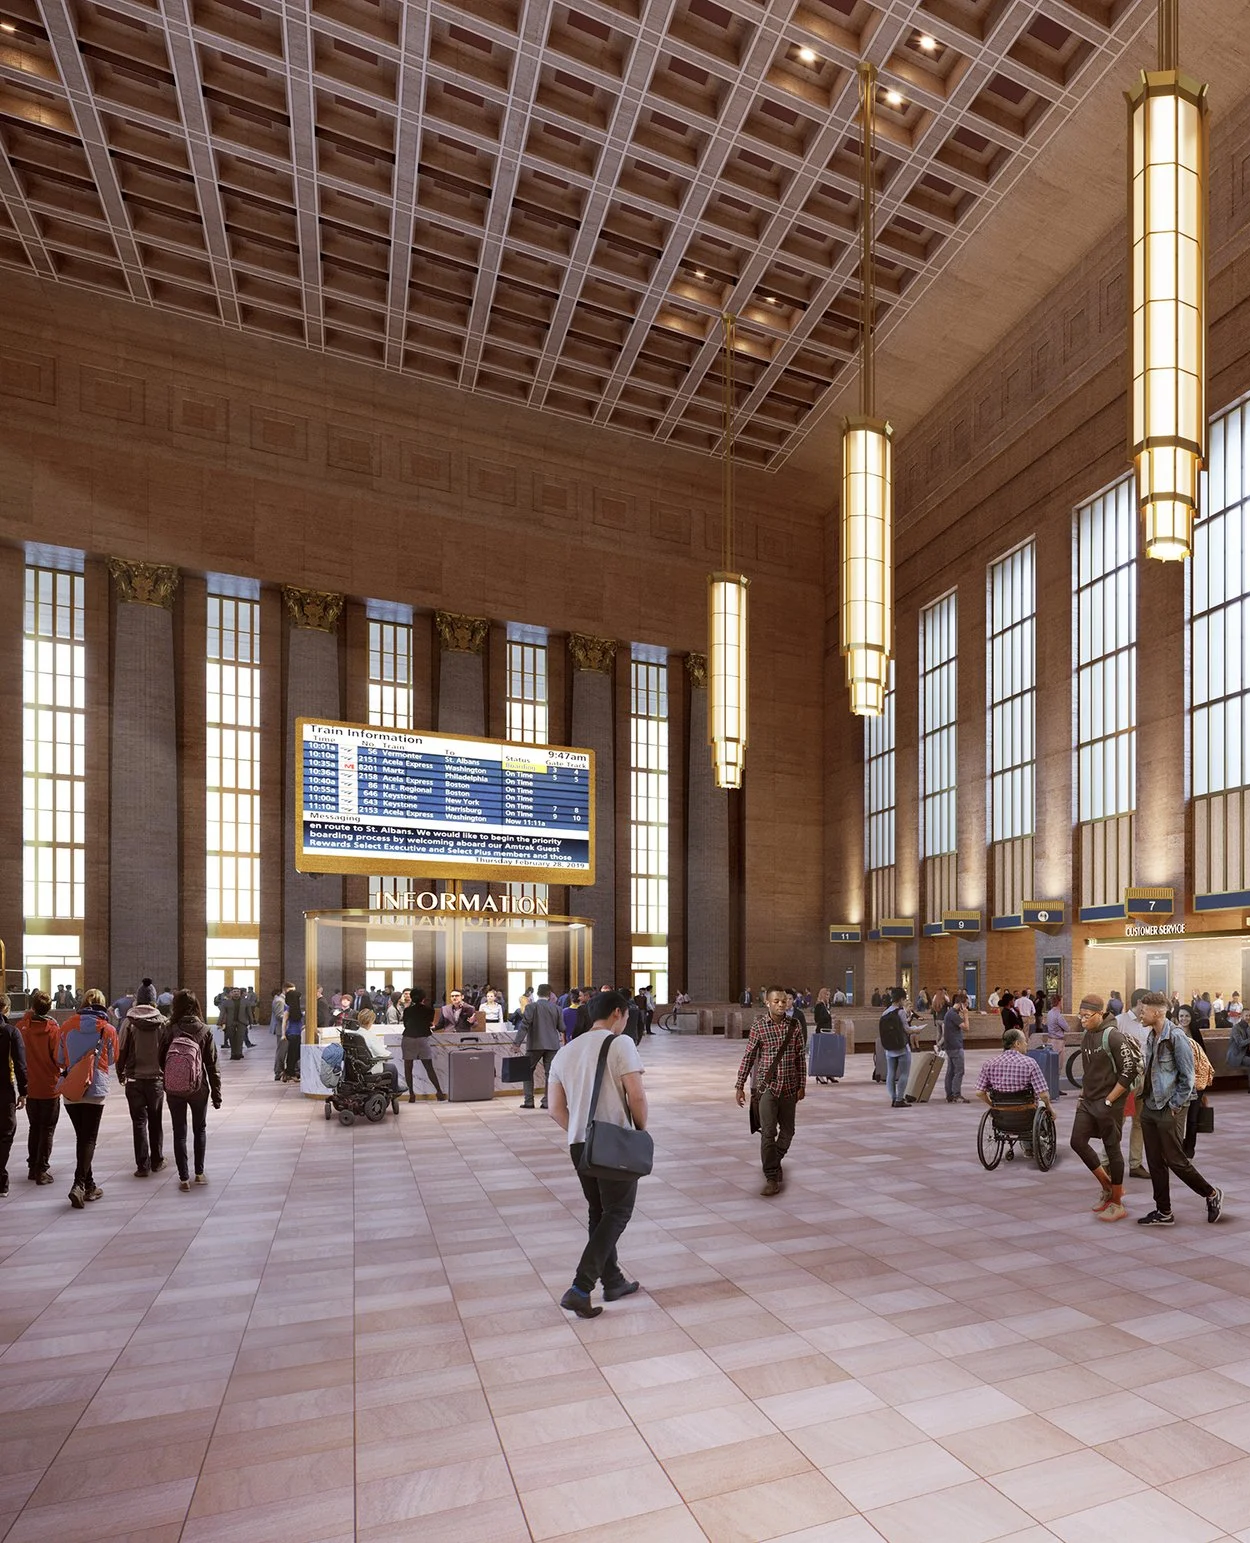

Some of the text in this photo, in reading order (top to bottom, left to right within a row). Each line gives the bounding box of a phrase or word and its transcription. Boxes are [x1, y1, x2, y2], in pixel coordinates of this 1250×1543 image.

[311, 725, 423, 745] Train Information
[308, 742, 336, 751] 10:01a
[382, 750, 422, 760] Vermonter
[456, 758, 480, 766] Albans
[308, 751, 336, 759] 10:10a
[383, 758, 403, 766] Acela
[406, 761, 433, 770] Express
[445, 765, 486, 775] Washington
[506, 756, 531, 764] Status
[548, 750, 587, 762] 9:47am
[308, 759, 336, 768] 10:35a
[358, 764, 378, 772] 8201
[383, 766, 405, 775] Martz
[445, 773, 488, 783] Philadelphia
[308, 768, 336, 776] 10:36a
[383, 775, 403, 783] Acela
[406, 777, 433, 787] Express
[445, 781, 470, 789] Boston
[308, 777, 336, 785] 10:40a
[400, 786, 432, 795] Regional
[445, 789, 470, 797] Boston
[308, 785, 336, 793] 10:55a
[383, 792, 417, 802] Keystone
[463, 798, 480, 806] York
[308, 794, 336, 802] 11:00a
[383, 800, 417, 810] Keystone
[445, 805, 482, 815] Harrisburg
[308, 803, 336, 811] 11:10a
[406, 810, 434, 819] Express
[445, 813, 487, 823] Washington
[523, 819, 546, 827] 11:11a
[310, 812, 361, 823] Messaging
[309, 830, 353, 841] boarding
[356, 834, 390, 842] process
[393, 835, 404, 844] by
[407, 837, 454, 847] welcoming
[457, 840, 485, 848] aboard
[504, 843, 535, 851] Amtrak
[381, 827, 414, 835] Albans.
[491, 834, 514, 843] begin
[532, 837, 562, 846] priority
[309, 840, 351, 848] Rewards
[353, 842, 381, 850] Select
[384, 844, 426, 852] Executive
[550, 853, 572, 861] those
[475, 857, 513, 865] Thursday
[515, 859, 550, 868] February
[376, 891, 549, 915] INFORMATION
[1149, 901, 1156, 911] 7
[958, 921, 964, 929] 9
[1125, 923, 1185, 937] CUSTOMER SERVICE
